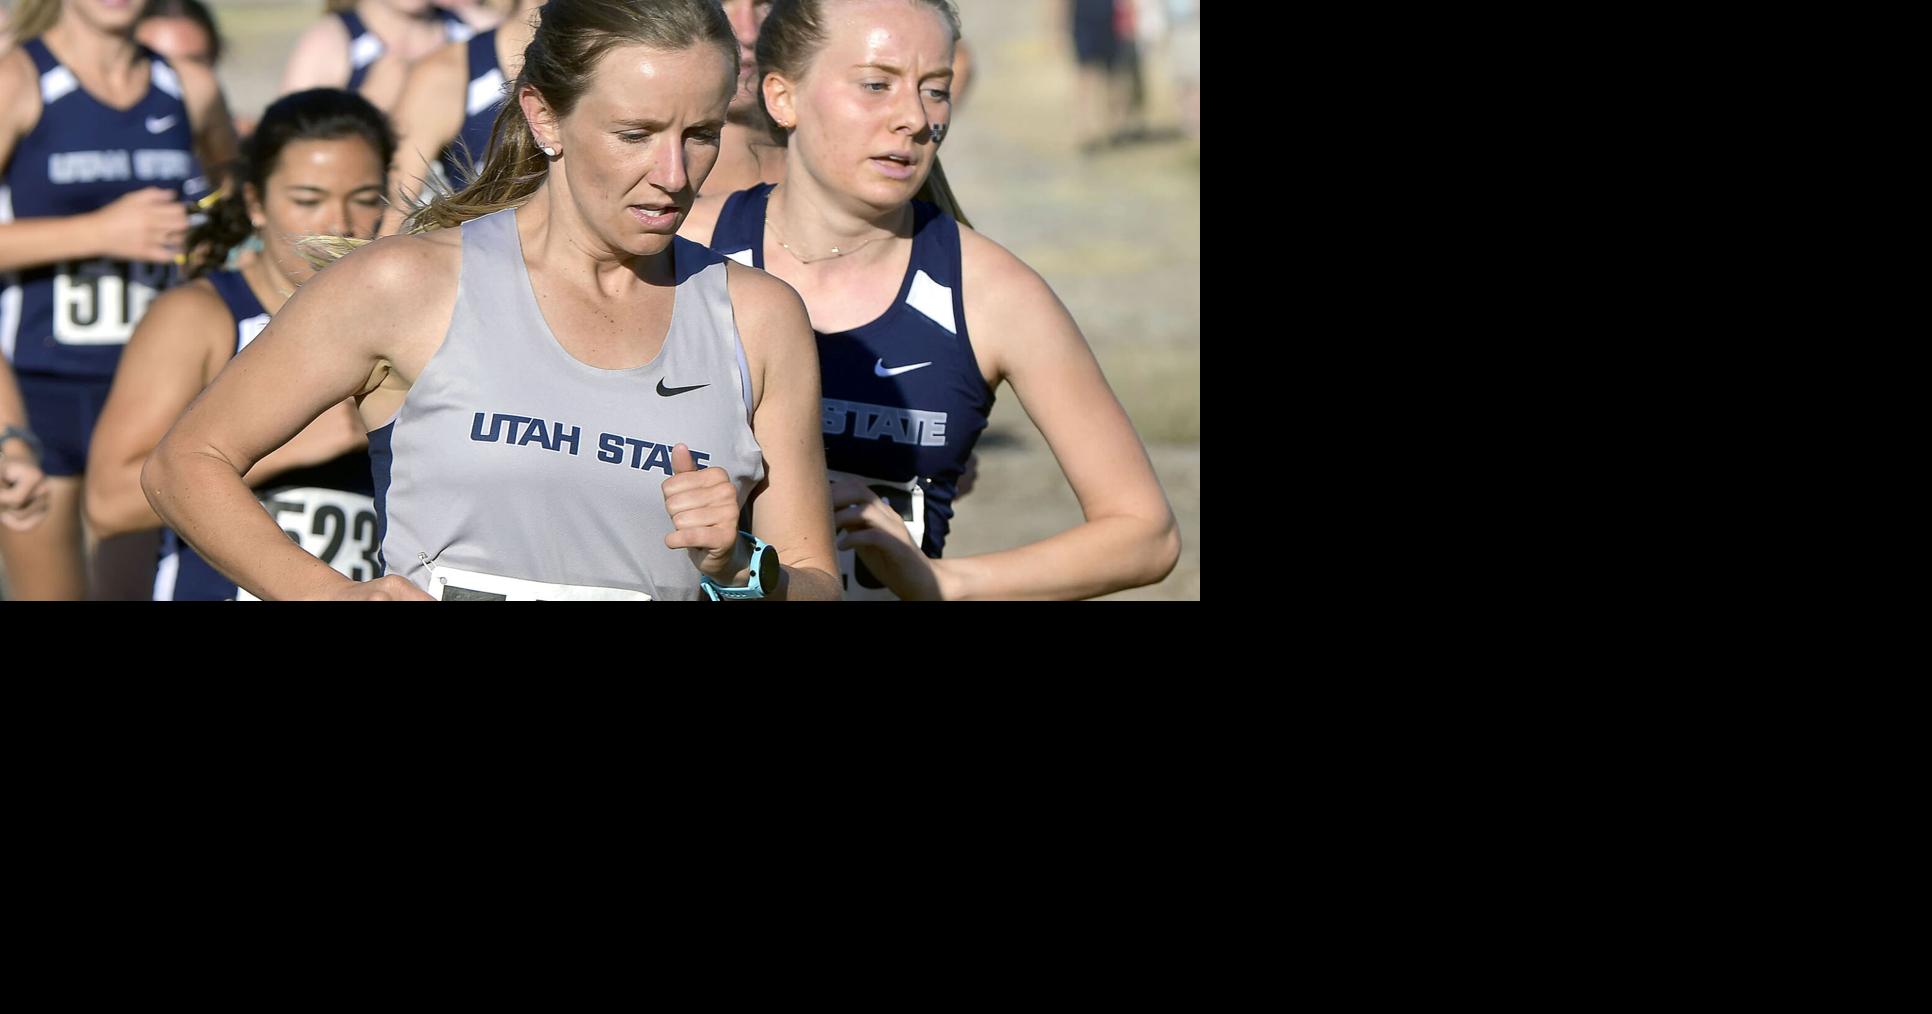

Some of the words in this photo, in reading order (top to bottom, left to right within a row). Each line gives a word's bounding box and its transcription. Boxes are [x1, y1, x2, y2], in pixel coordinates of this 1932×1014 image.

[469, 411, 582, 457] UTAH
[596, 432, 711, 477] STAE
[822, 398, 948, 447] STATE
